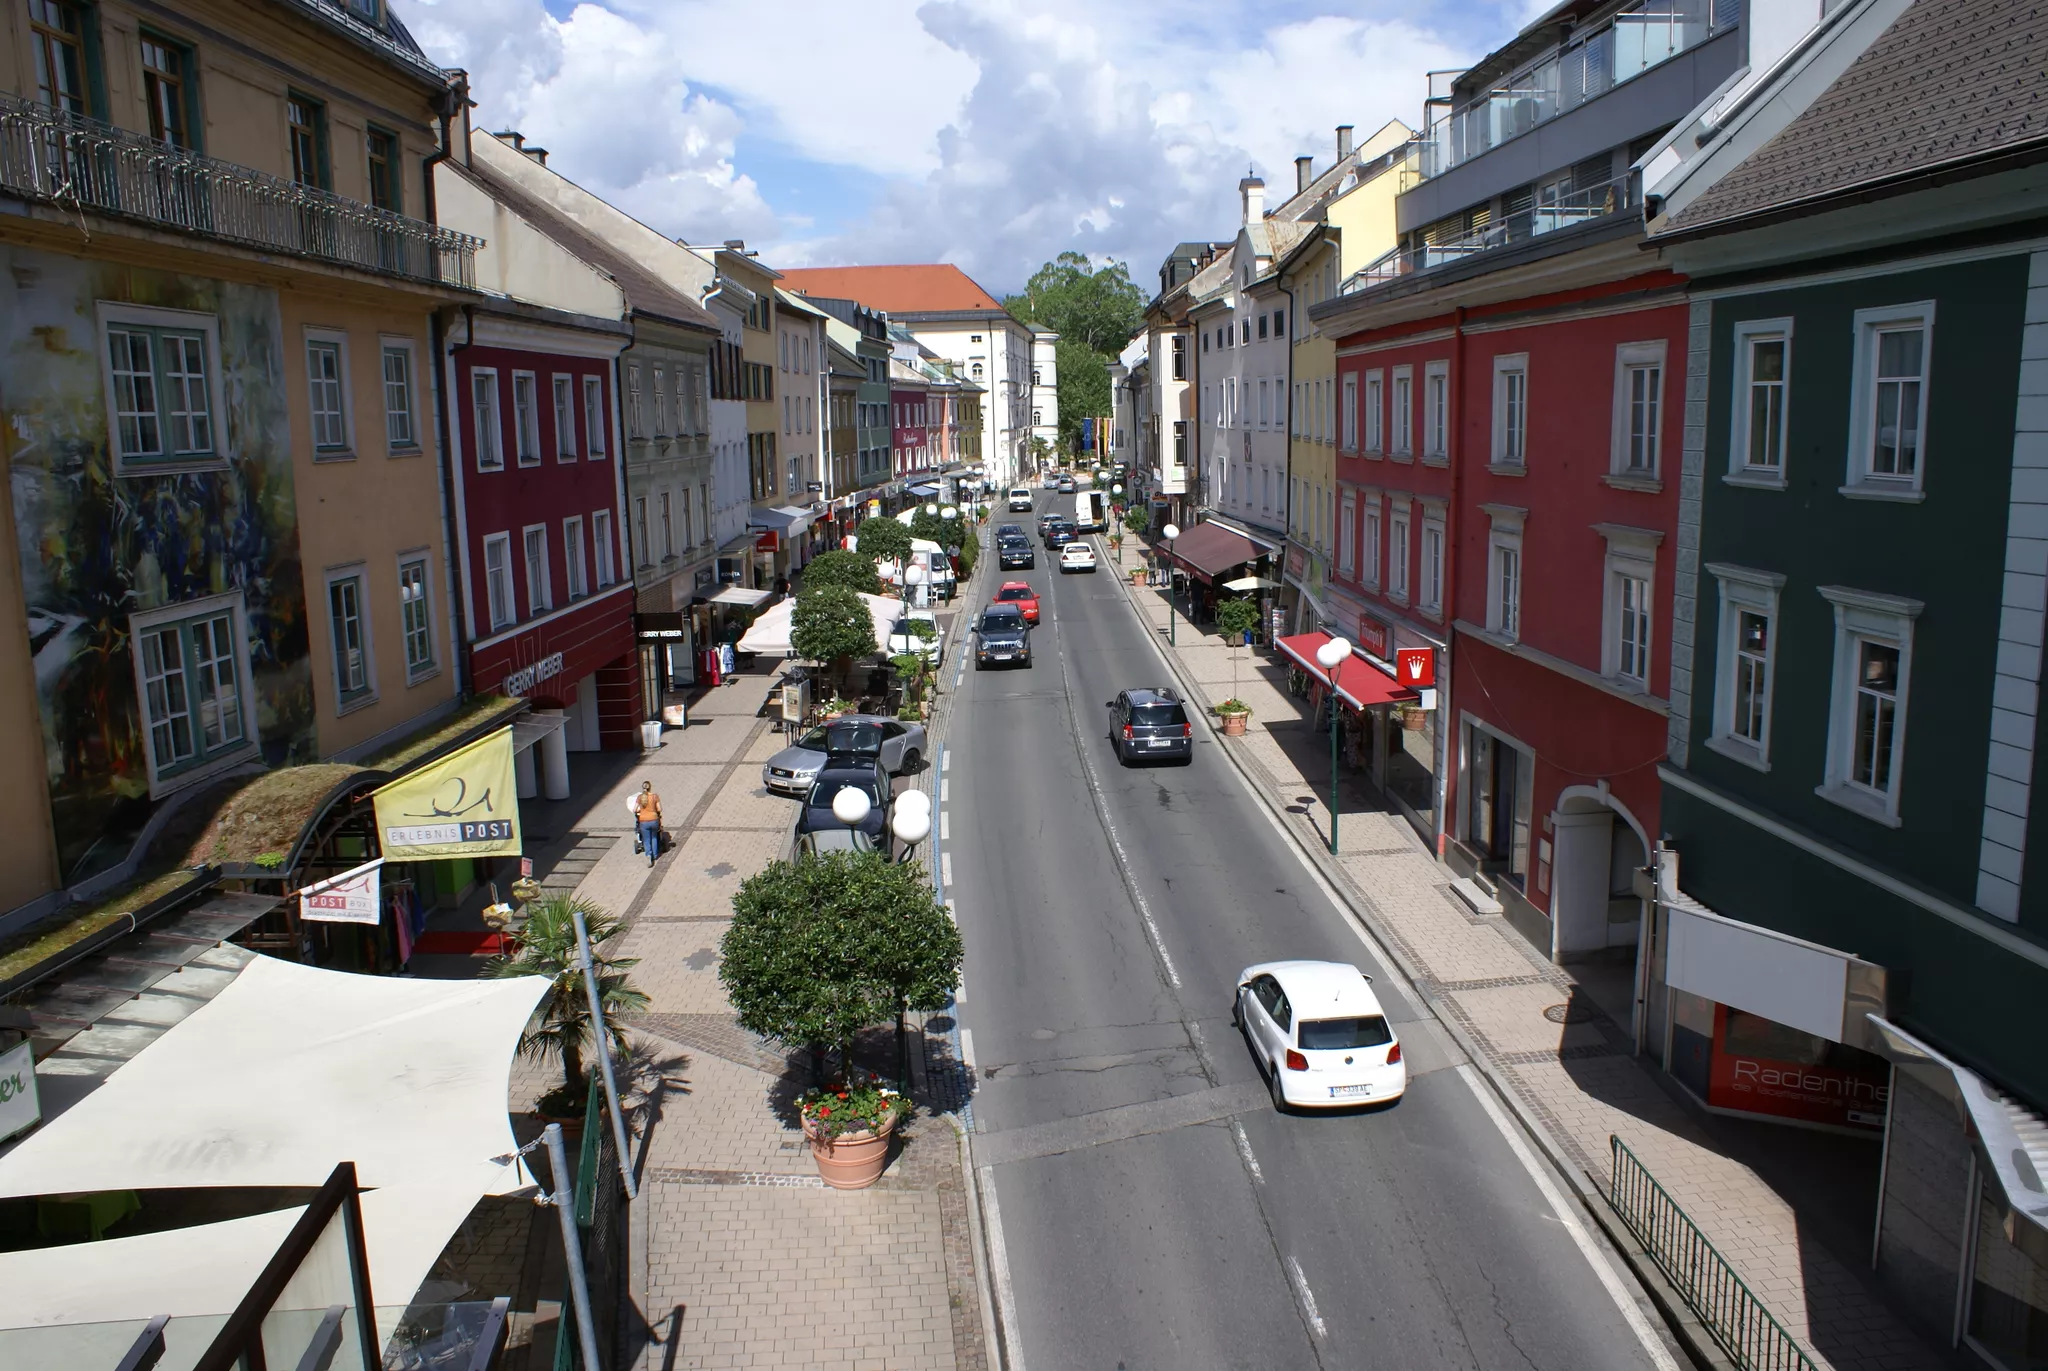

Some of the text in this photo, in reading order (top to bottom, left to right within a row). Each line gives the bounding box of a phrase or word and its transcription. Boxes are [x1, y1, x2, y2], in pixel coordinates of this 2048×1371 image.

[1361, 622, 1379, 648] Triumph
[507, 652, 563, 697] GERRY WEBER
[391, 822, 509, 841] ERLEBNIS POST
[311, 897, 344, 907] POST
